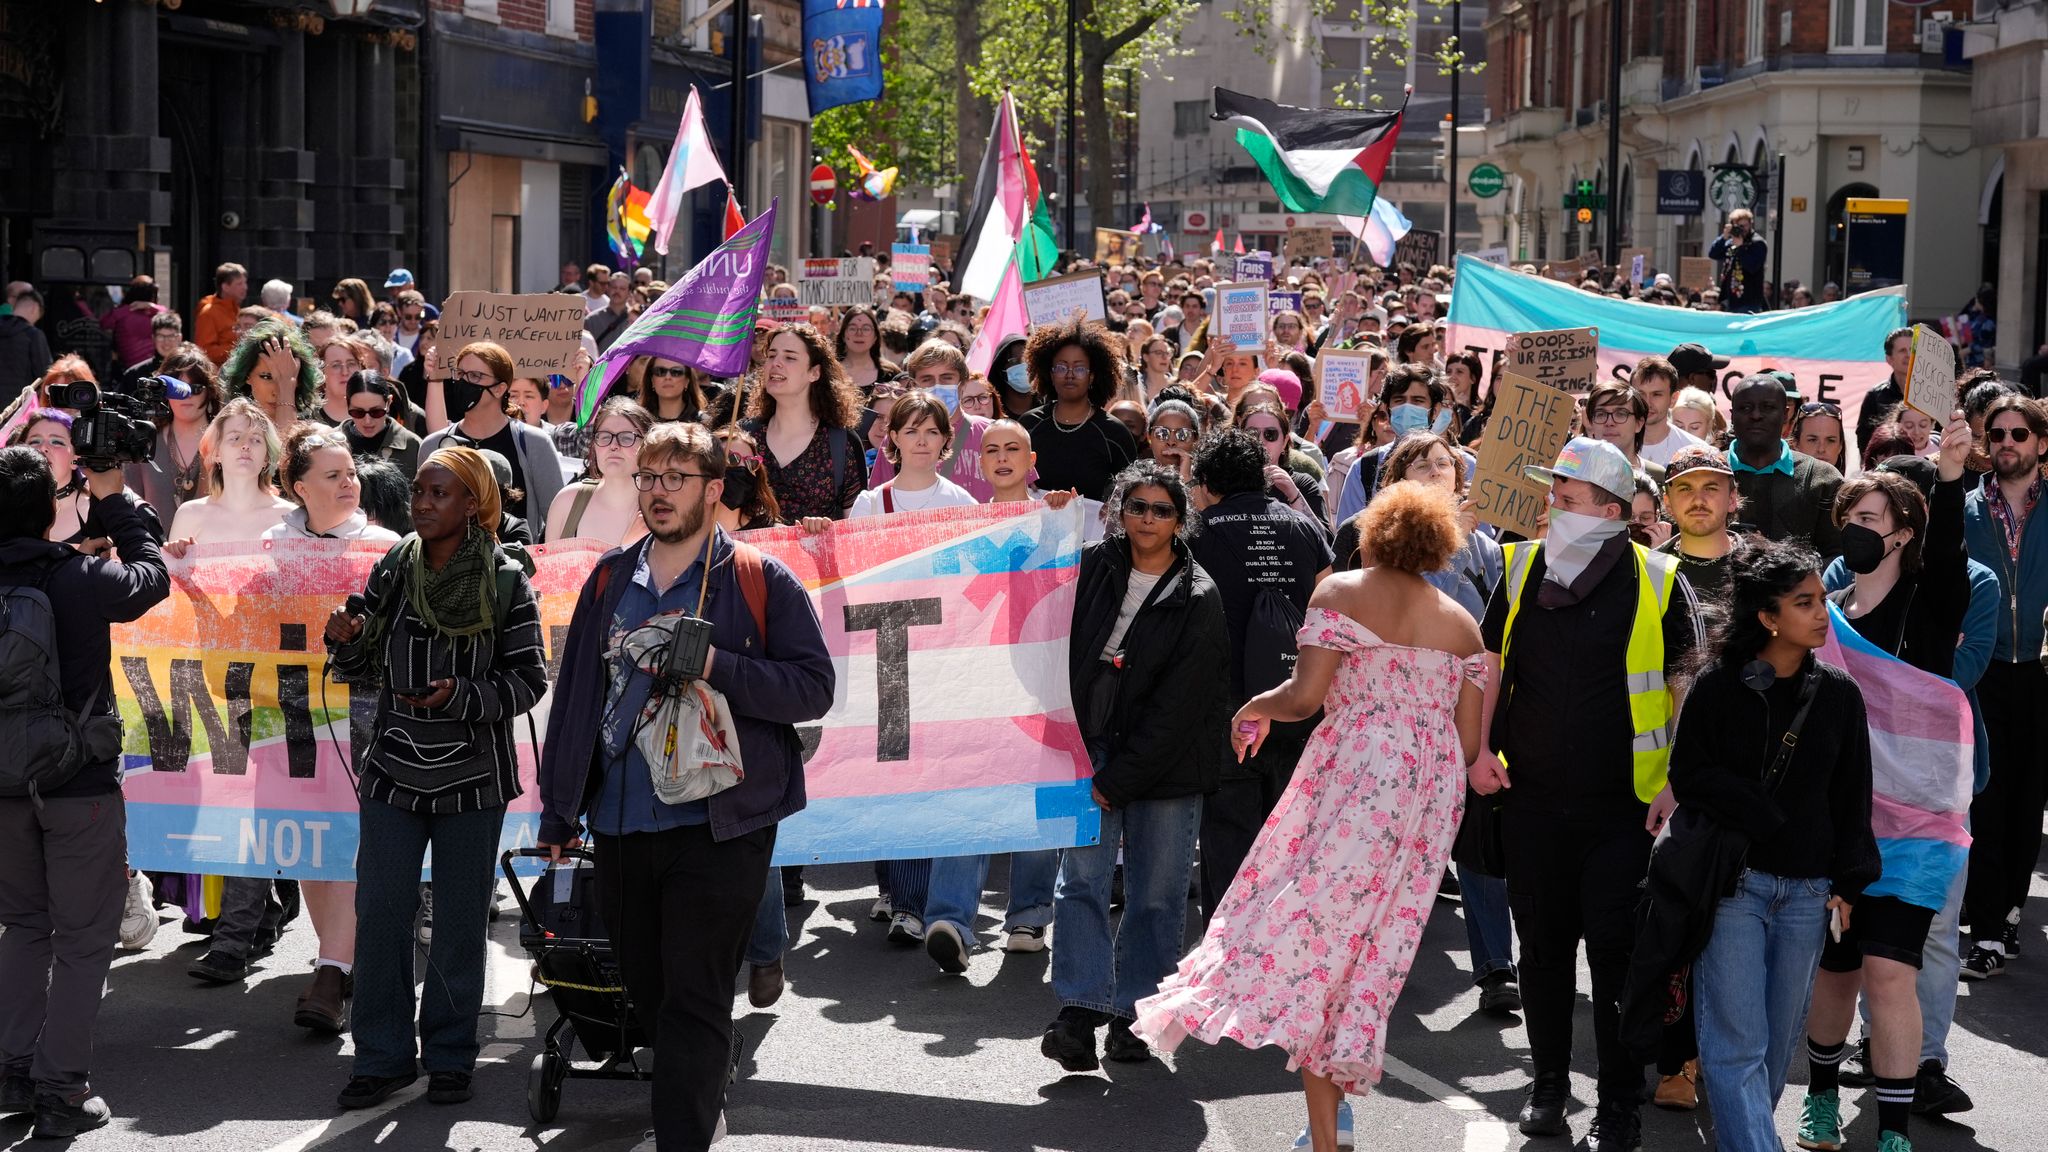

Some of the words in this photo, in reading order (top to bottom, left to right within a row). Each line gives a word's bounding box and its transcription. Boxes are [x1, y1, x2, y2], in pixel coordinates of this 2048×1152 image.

[1660, 197, 1699, 206] Leonidas
[843, 259, 858, 277] FOR
[1236, 258, 1265, 274] Trans
[799, 279, 826, 305] TRANS
[827, 279, 872, 304] LIBERATION
[459, 300, 464, 317] I
[472, 302, 518, 322] JUST
[523, 307, 567, 322] WANT
[568, 308, 583, 320] TO
[1223, 303, 1263, 314] WOMEN
[1267, 297, 1294, 310] rans
[1233, 313, 1253, 323] ARE
[443, 324, 478, 339] LIVE
[482, 327, 492, 338] A
[499, 326, 562, 341] PEACEFUL
[565, 329, 583, 340] LIFE
[1230, 322, 1257, 332] REAL
[516, 352, 568, 368] ALONE!
[1517, 351, 1534, 365] UR
[1538, 346, 1597, 362] FASCISM
[1536, 365, 1566, 378] IS
[1915, 355, 1937, 383] SICK
[1936, 371, 1947, 388] OF
[1539, 372, 1594, 391] WING!
[1515, 384, 1562, 426] THE
[1923, 385, 1948, 413] SHIT
[1497, 415, 1559, 460] DOLLS
[1209, 516, 1226, 526] REMI
[1225, 513, 1248, 521] WOLF
[237, 818, 331, 868] NOT
